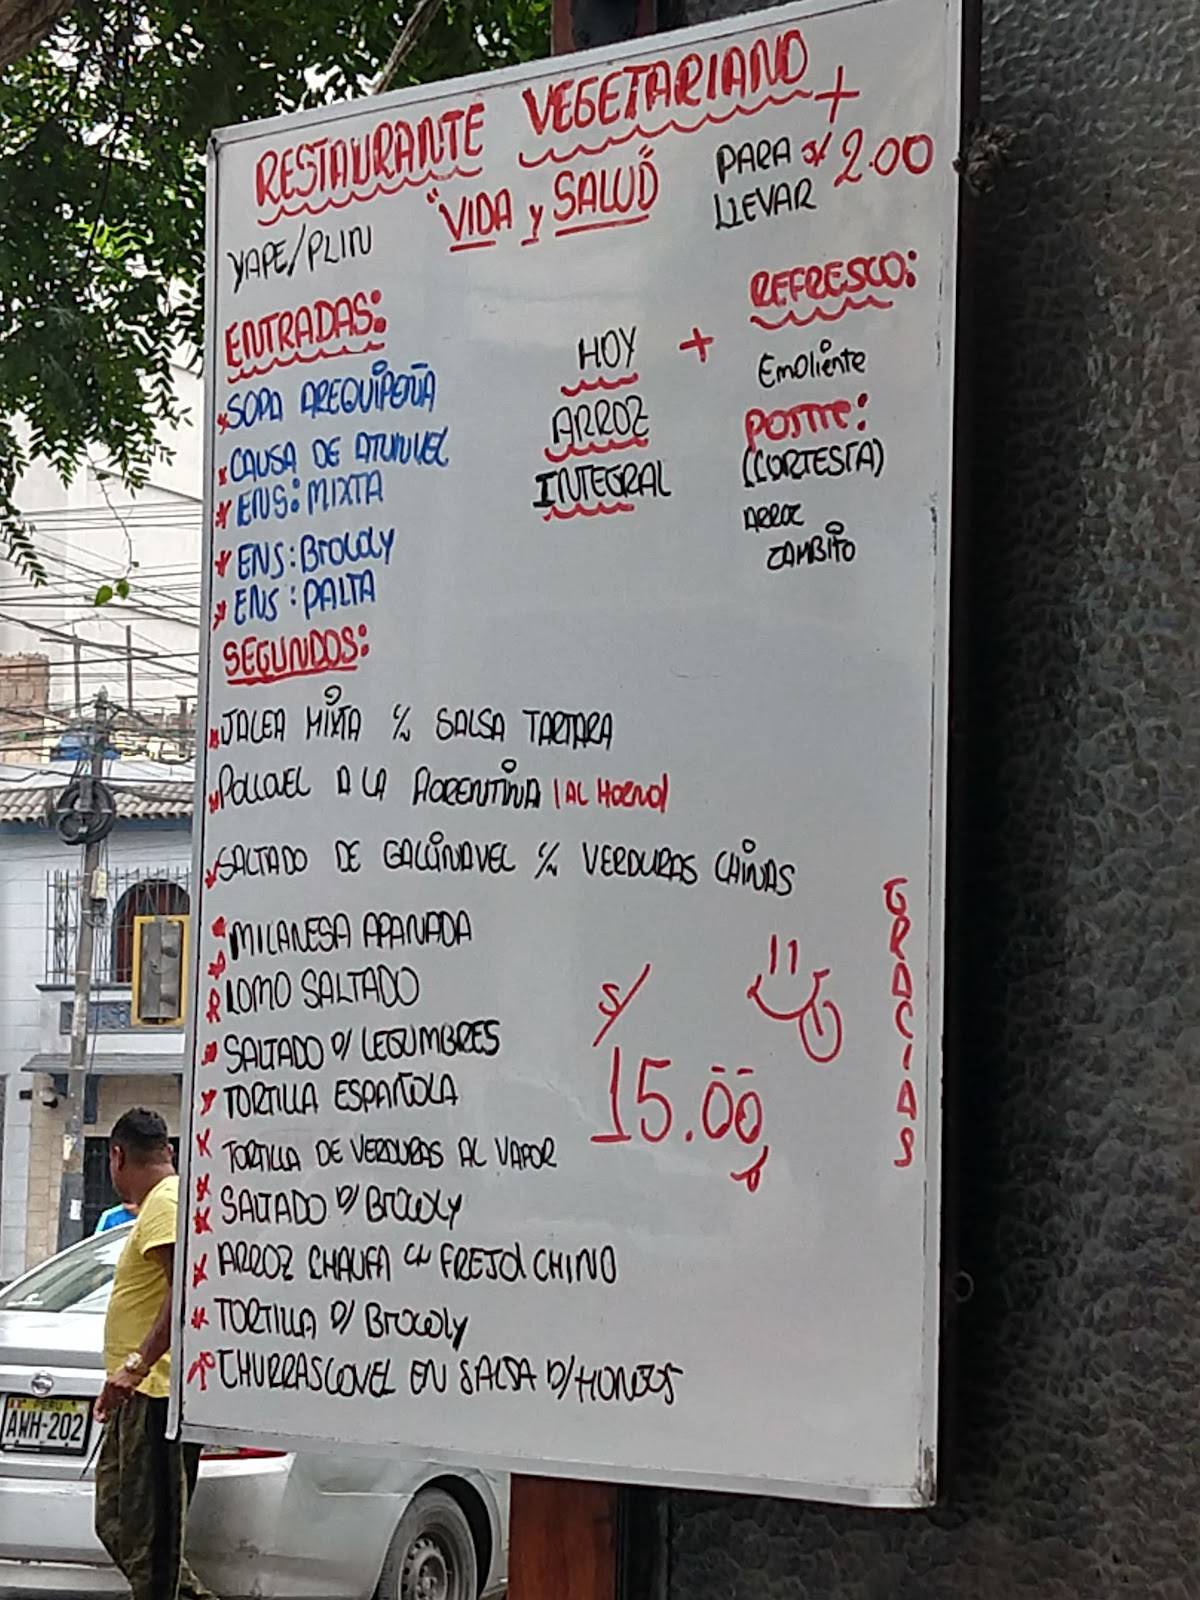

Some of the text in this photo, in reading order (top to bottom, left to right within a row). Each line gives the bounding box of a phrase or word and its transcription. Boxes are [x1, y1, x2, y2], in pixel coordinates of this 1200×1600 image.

[256, 29, 808, 207] RESTAURANTE VEGETARIANO
[716, 137, 791, 184] PARA
[834, 128, 934, 188] 2.00
[713, 178, 817, 230] LLEVAR
[227, 223, 372, 294] YAPE/PLIN
[750, 250, 917, 308] REFRESCO:
[225, 289, 387, 367] ENTRADAS:
[578, 326, 637, 370] HOY
[227, 386, 283, 430] SOPA
[552, 396, 650, 444] ARROZ
[230, 441, 297, 482] CAUSA
[312, 437, 341, 466] DE
[308, 469, 383, 514] MIXTA
[533, 460, 671, 508] INTEGRAL
[304, 569, 376, 621] PALTA
[224, 624, 369, 679] SEGUNDOS:
[221, 706, 286, 745] JALEA
[306, 684, 362, 743] MIXTA
[436, 707, 504, 742] SALSA
[523, 710, 614, 750] TARTARA
[337, 766, 350, 795] A
[362, 766, 387, 801] LA
[218, 844, 308, 881] SALTADO
[335, 840, 361, 873] DE
[582, 841, 698, 886] VERDURAS
[715, 838, 796, 896] CHINAS
[230, 910, 473, 959] MILANESA APANADA
[226, 965, 419, 1014] LOMO SALTADO
[225, 1034, 324, 1073] SALTADO
[362, 1020, 500, 1061] LEGUMBRES
[224, 1073, 458, 1118] TORTILLA ESPAÑOLA
[591, 1046, 763, 1144] 15.00
[223, 1134, 557, 1171] TORTILLA DE VERDURAS AL VAPOR
[221, 1185, 326, 1225] SALTADO
[216, 1242, 294, 1280] ARROZ
[309, 1243, 392, 1282] CHAUFA
[533, 1245, 617, 1284] CHINO
[214, 1298, 316, 1339] TORTILLA
[412, 1359, 447, 1393] EN
[460, 1356, 537, 1393] SALSA
[6, 1411, 83, 1441] AWH-202
